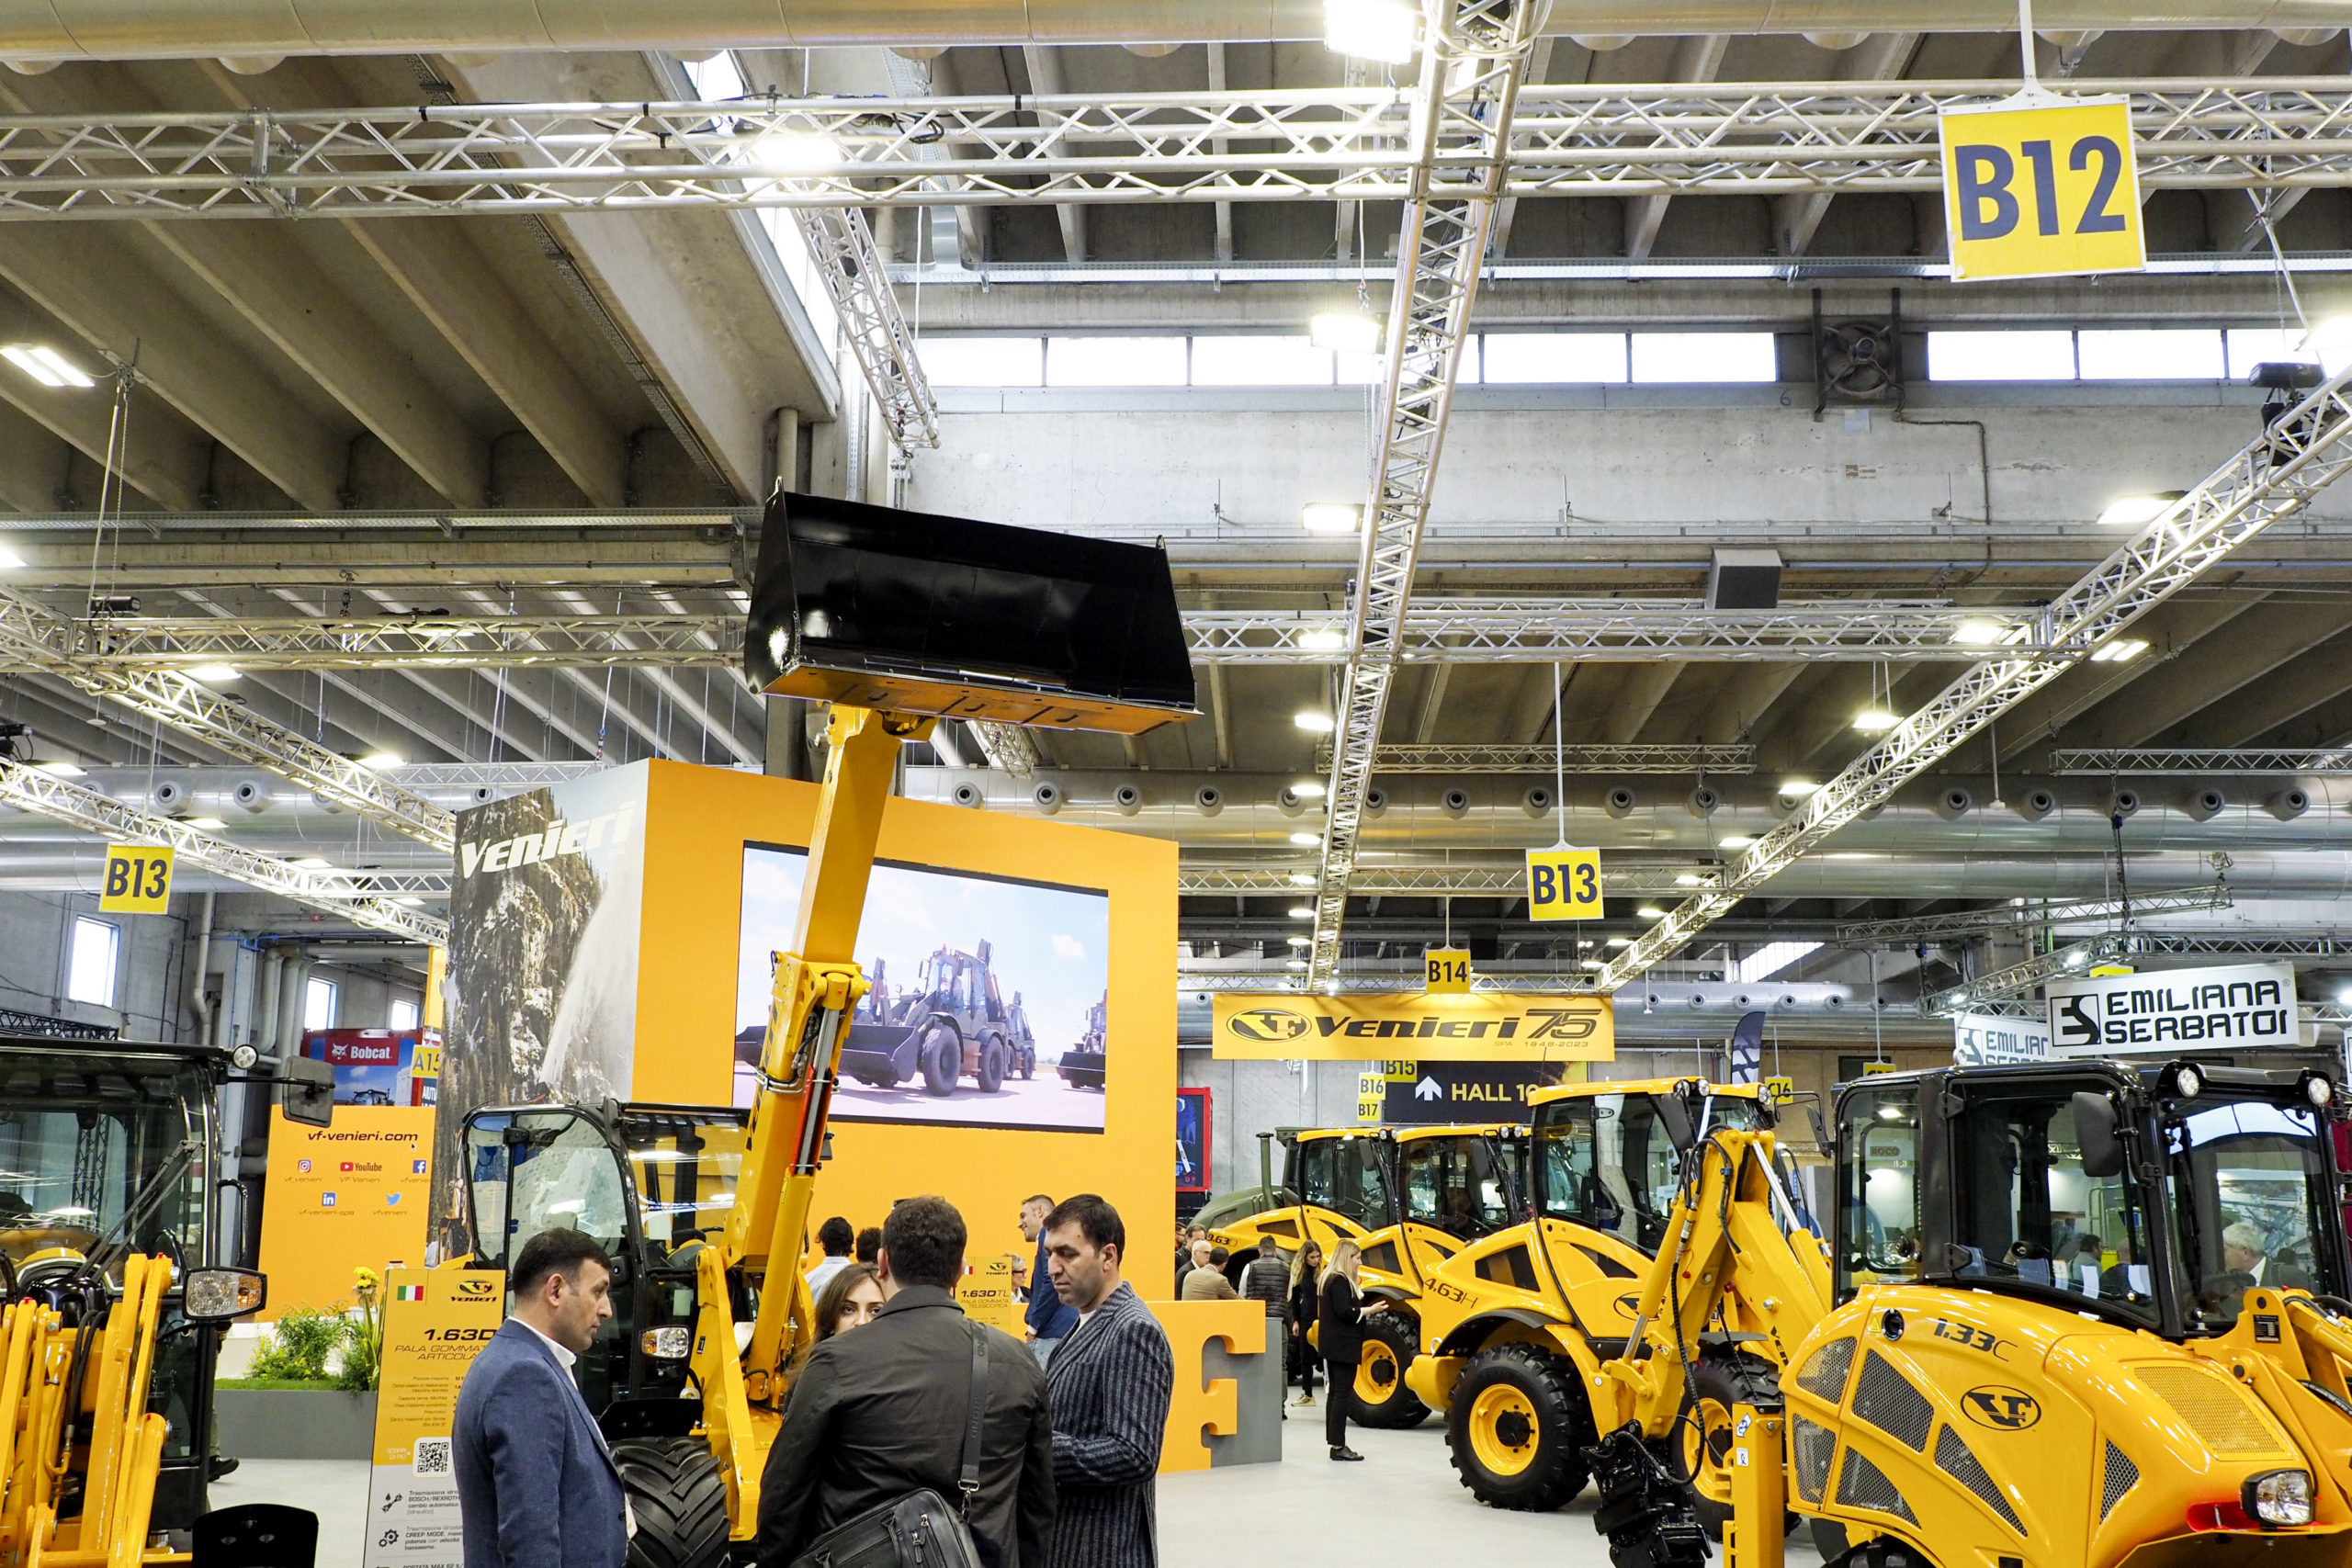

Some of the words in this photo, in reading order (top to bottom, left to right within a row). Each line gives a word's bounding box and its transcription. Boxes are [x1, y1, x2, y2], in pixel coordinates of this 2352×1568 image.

[1955, 136, 2126, 241] B12
[106, 858, 167, 898] B13
[1532, 863, 1598, 904] B13
[1429, 960, 1467, 983] B14
[2107, 980, 2280, 1016] EMILIANA
[1526, 1009, 1602, 1039] 75
[2104, 1010, 2287, 1043] SERBATOI
[350, 1046, 390, 1059] Bobcat
[1385, 1060, 1415, 1076] B15
[1360, 1078, 1384, 1094] B16
[1452, 1083, 1511, 1101] HALL
[1358, 1103, 1378, 1117] B17
[308, 1131, 418, 1142] vf-venieri.com
[355, 1162, 382, 1172] YouTube
[1424, 1278, 1478, 1309] 4.63H
[424, 1328, 497, 1341] 1.63D
[1934, 1318, 2018, 1362] 1.33C
